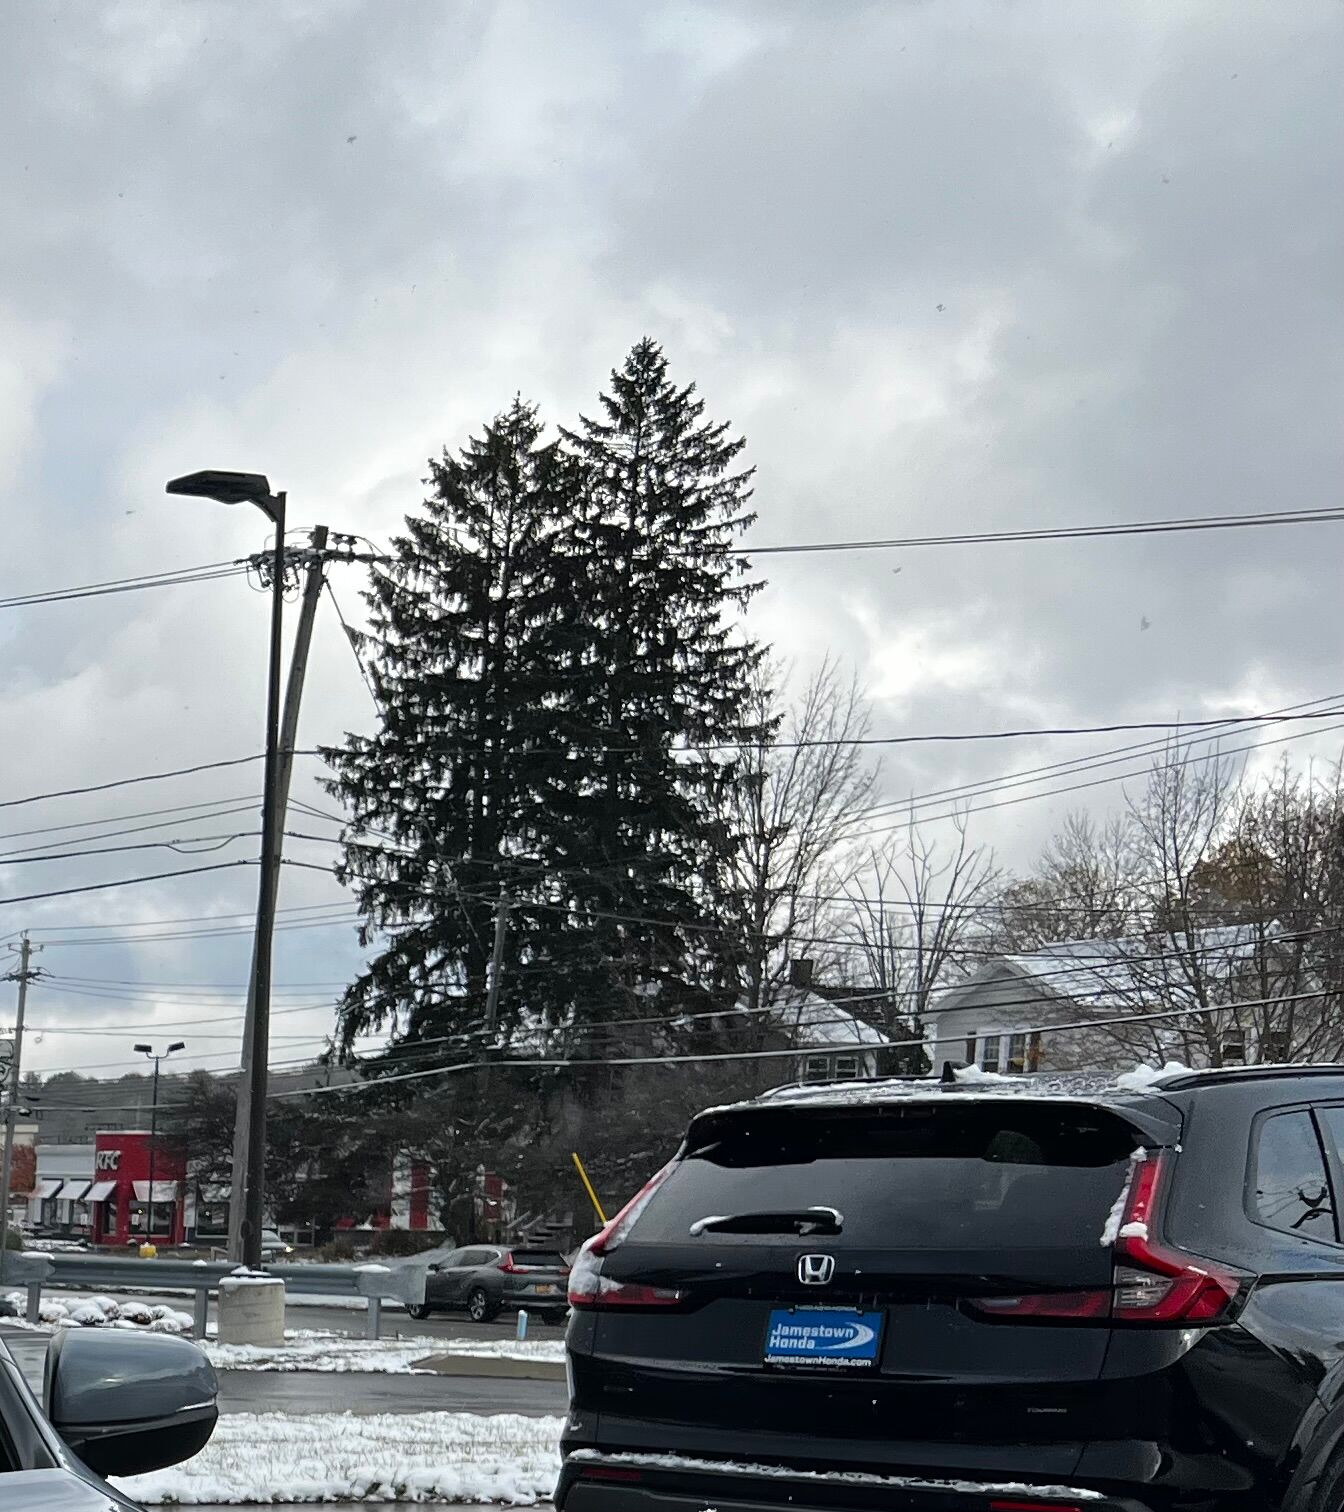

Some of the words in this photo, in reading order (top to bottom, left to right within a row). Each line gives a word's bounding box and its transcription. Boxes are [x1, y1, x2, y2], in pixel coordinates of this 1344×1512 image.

[96, 1150, 121, 1170] KFC
[772, 1323, 854, 1338] Jamestown
[769, 1336, 816, 1350] Honda
[764, 1354, 872, 1367] JamestownHonda.com
